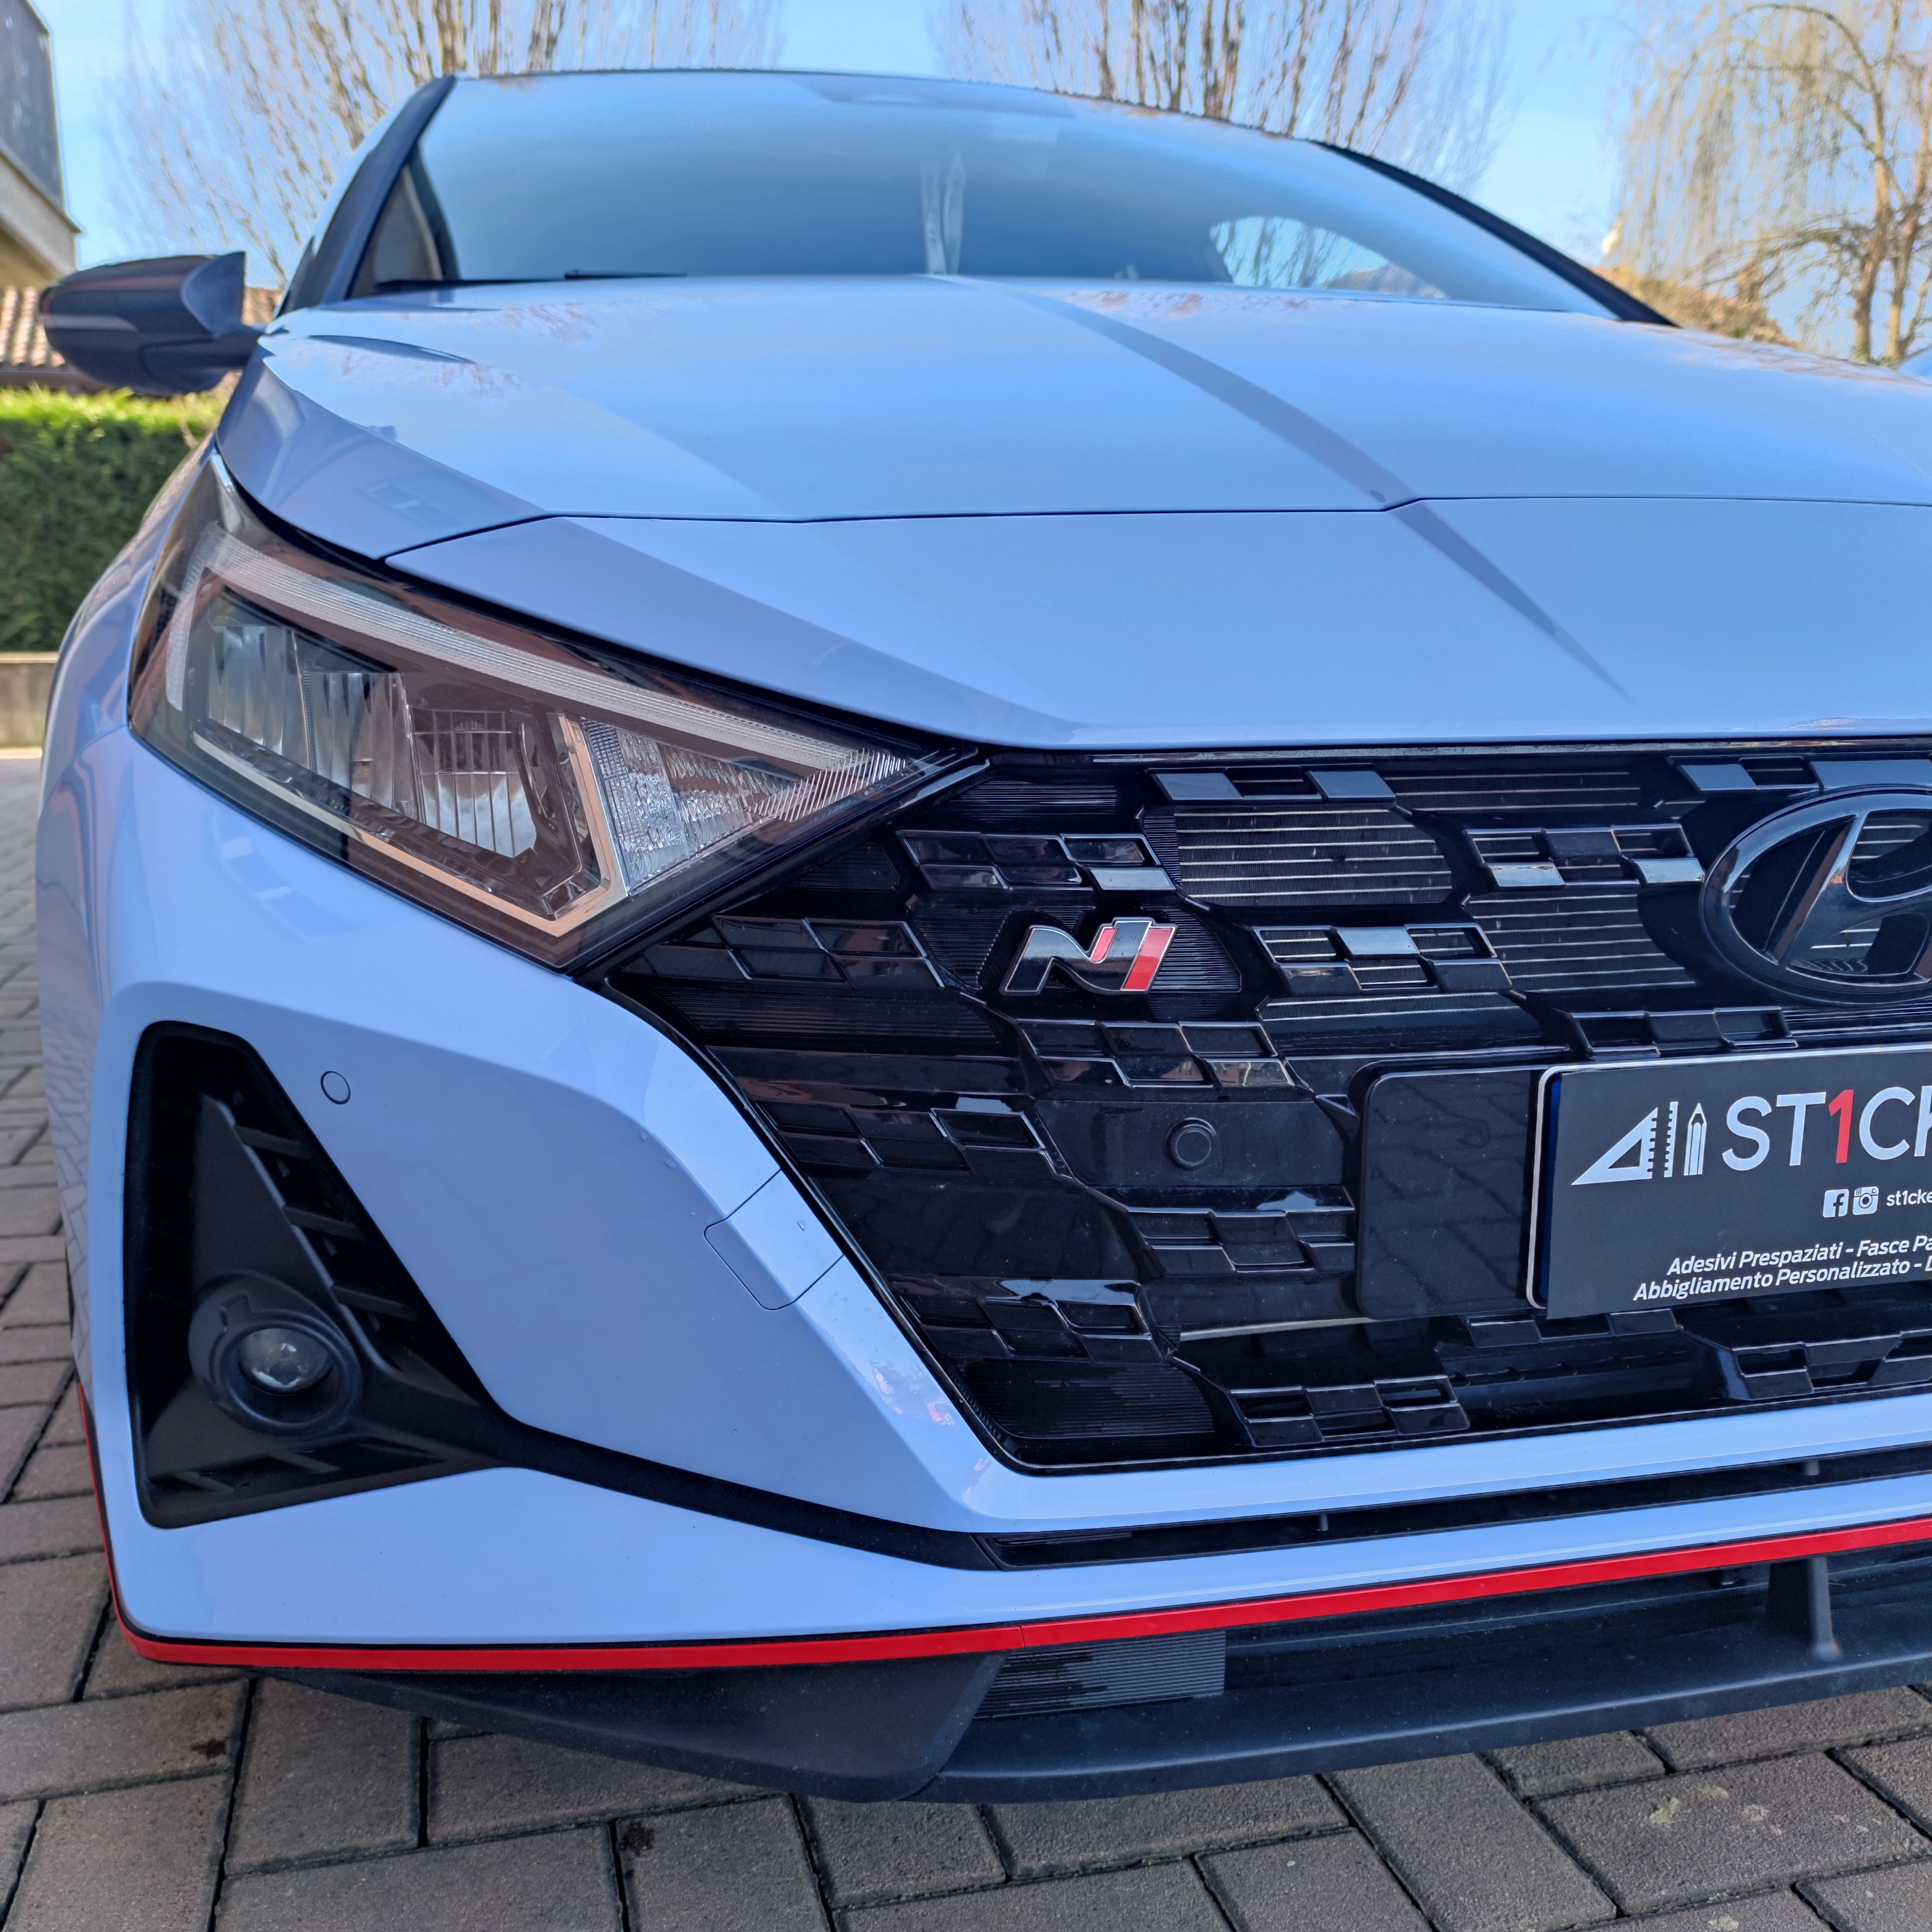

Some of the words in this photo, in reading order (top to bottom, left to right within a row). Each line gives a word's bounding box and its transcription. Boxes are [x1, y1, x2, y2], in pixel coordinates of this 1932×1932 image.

[999, 917, 1179, 996] N
[1886, 1189, 1932, 1206] st1cke
[1666, 1252, 1737, 1276] Adesivi
[1739, 1242, 1844, 1268] Prespaziati
[1856, 1240, 1910, 1257] Fasce
[1633, 1272, 1773, 1301] Abbigliamento
[1775, 1259, 1911, 1286] Personalizzato
